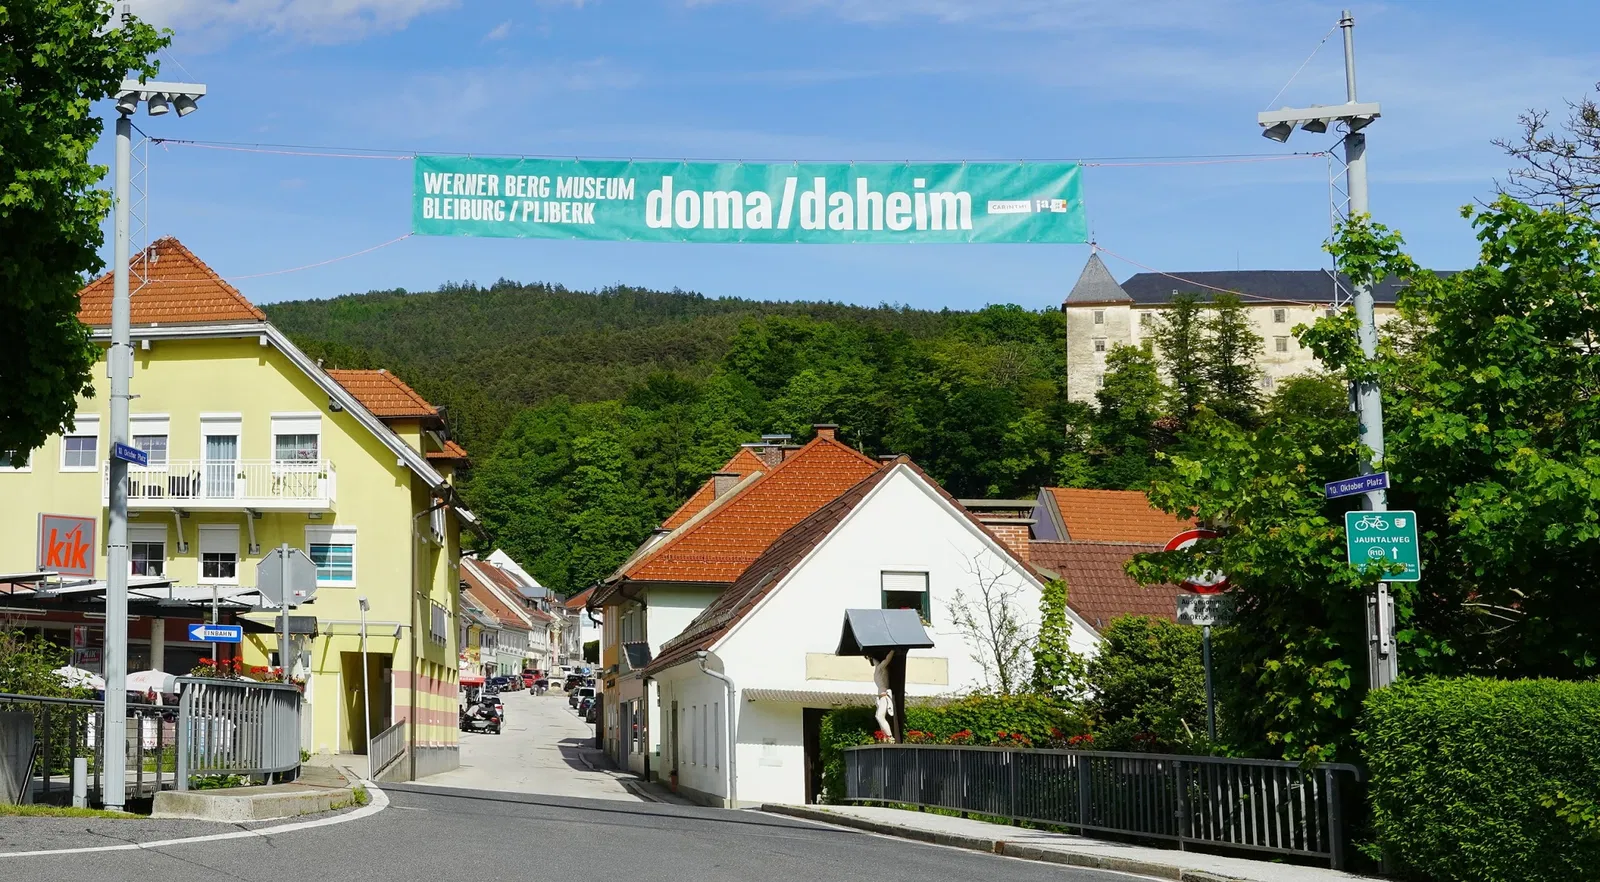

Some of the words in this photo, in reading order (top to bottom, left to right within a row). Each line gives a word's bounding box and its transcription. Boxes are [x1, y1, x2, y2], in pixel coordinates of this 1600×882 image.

[423, 172, 499, 196] WERNER
[505, 174, 550, 198] BERG
[556, 176, 635, 200] MUSEUM
[423, 197, 505, 222] BLEIBURG
[509, 200, 519, 222] /
[522, 200, 596, 224] PLIBERK
[1340, 481, 1364, 492] Oktober
[1366, 478, 1383, 487] Platz
[46, 523, 91, 569] kik
[1354, 536, 1410, 544] JAUNTALWEG
